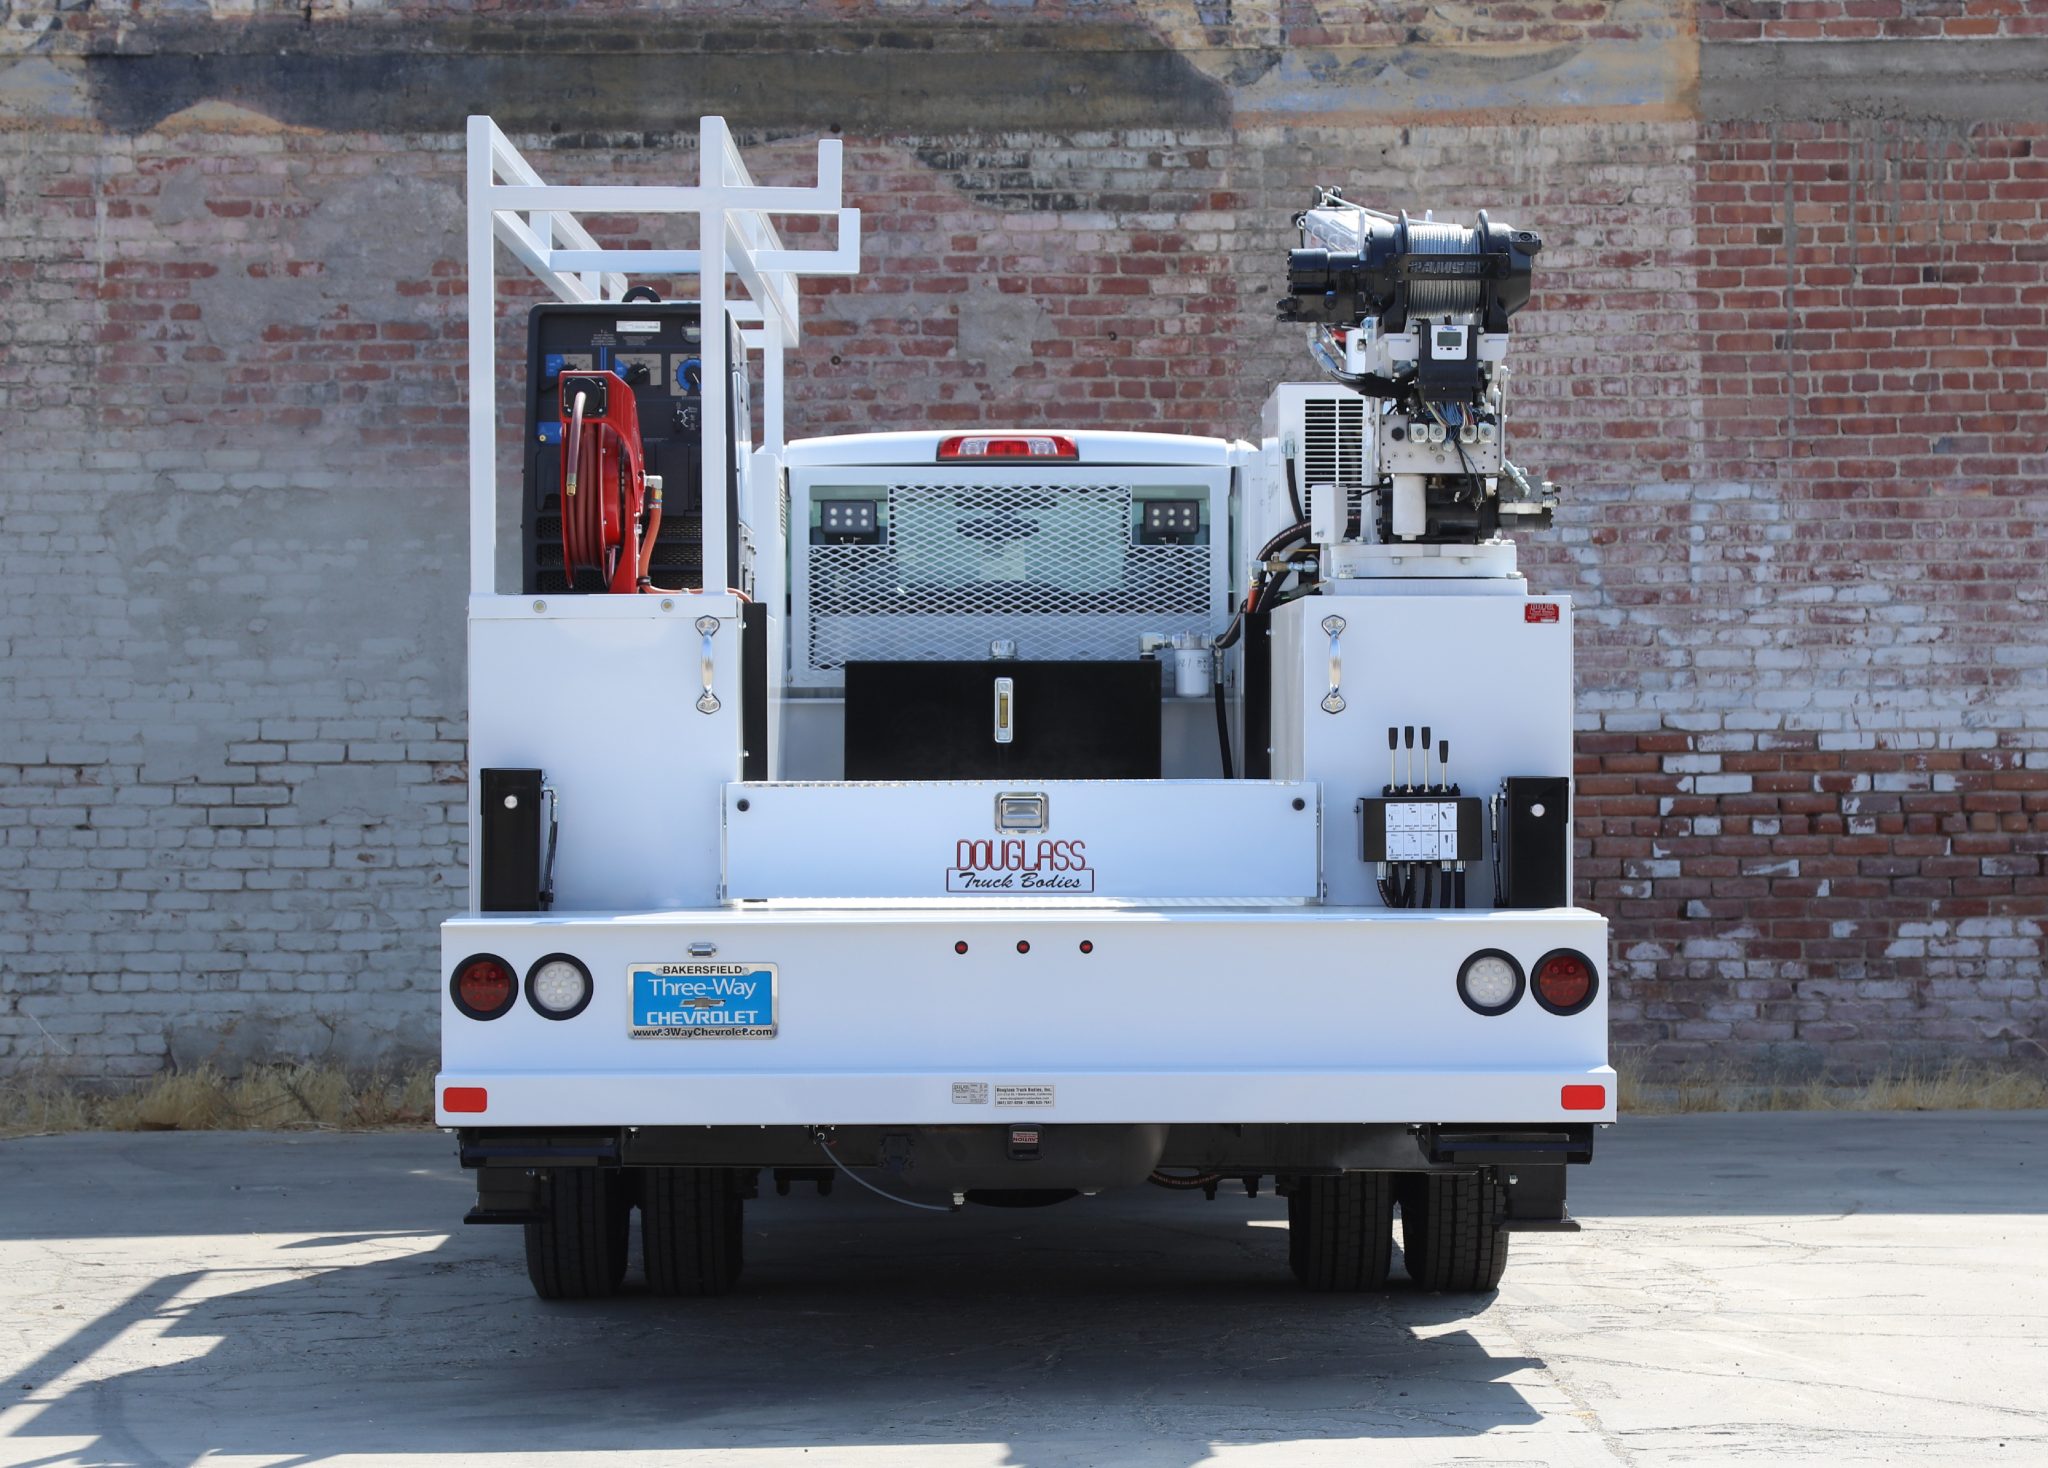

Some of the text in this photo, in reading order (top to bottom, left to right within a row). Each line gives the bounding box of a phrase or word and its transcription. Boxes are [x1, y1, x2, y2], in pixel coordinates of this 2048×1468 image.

[956, 839, 1086, 871] DOUGLASS
[958, 872, 1082, 889] Truck Bodies
[662, 965, 743, 975] BAKERSFIELD
[648, 978, 757, 1000] Three-Way
[646, 1010, 759, 1025] CHEVROLET
[633, 1027, 773, 1038] www.3WayChevrolet.com
